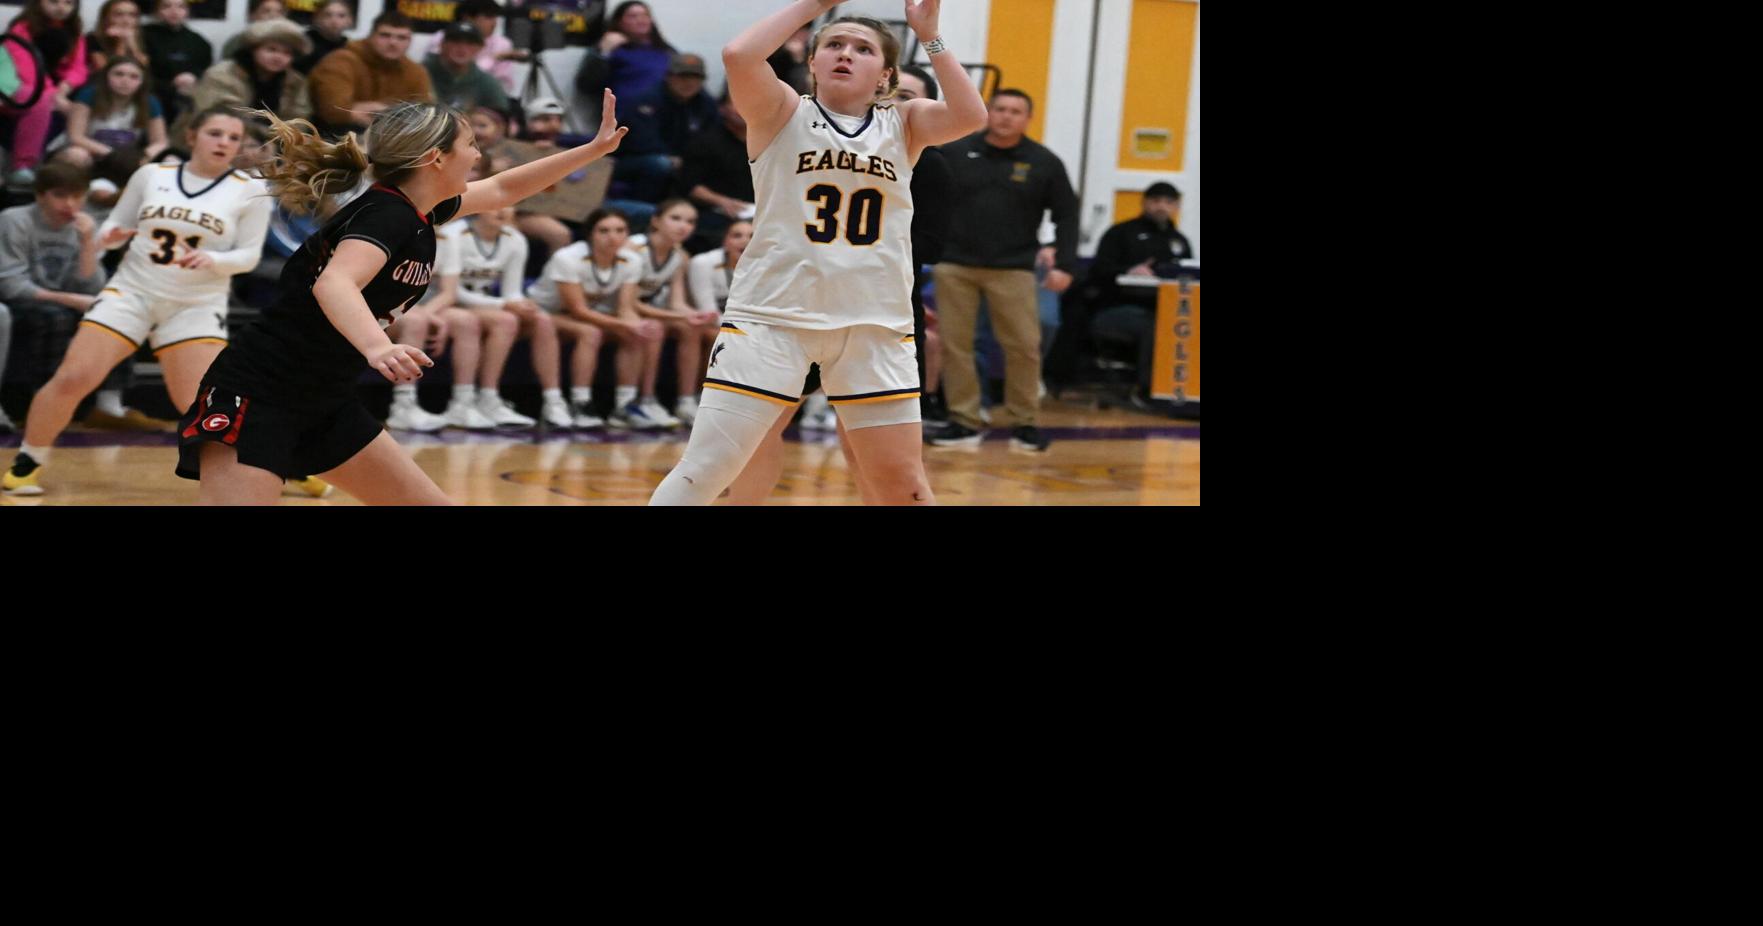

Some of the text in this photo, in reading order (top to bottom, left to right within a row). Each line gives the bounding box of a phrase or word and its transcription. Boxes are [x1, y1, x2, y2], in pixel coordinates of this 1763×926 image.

[796, 149, 898, 182] EAGLES
[139, 205, 224, 236] EAGLES
[804, 182, 885, 247] 30
